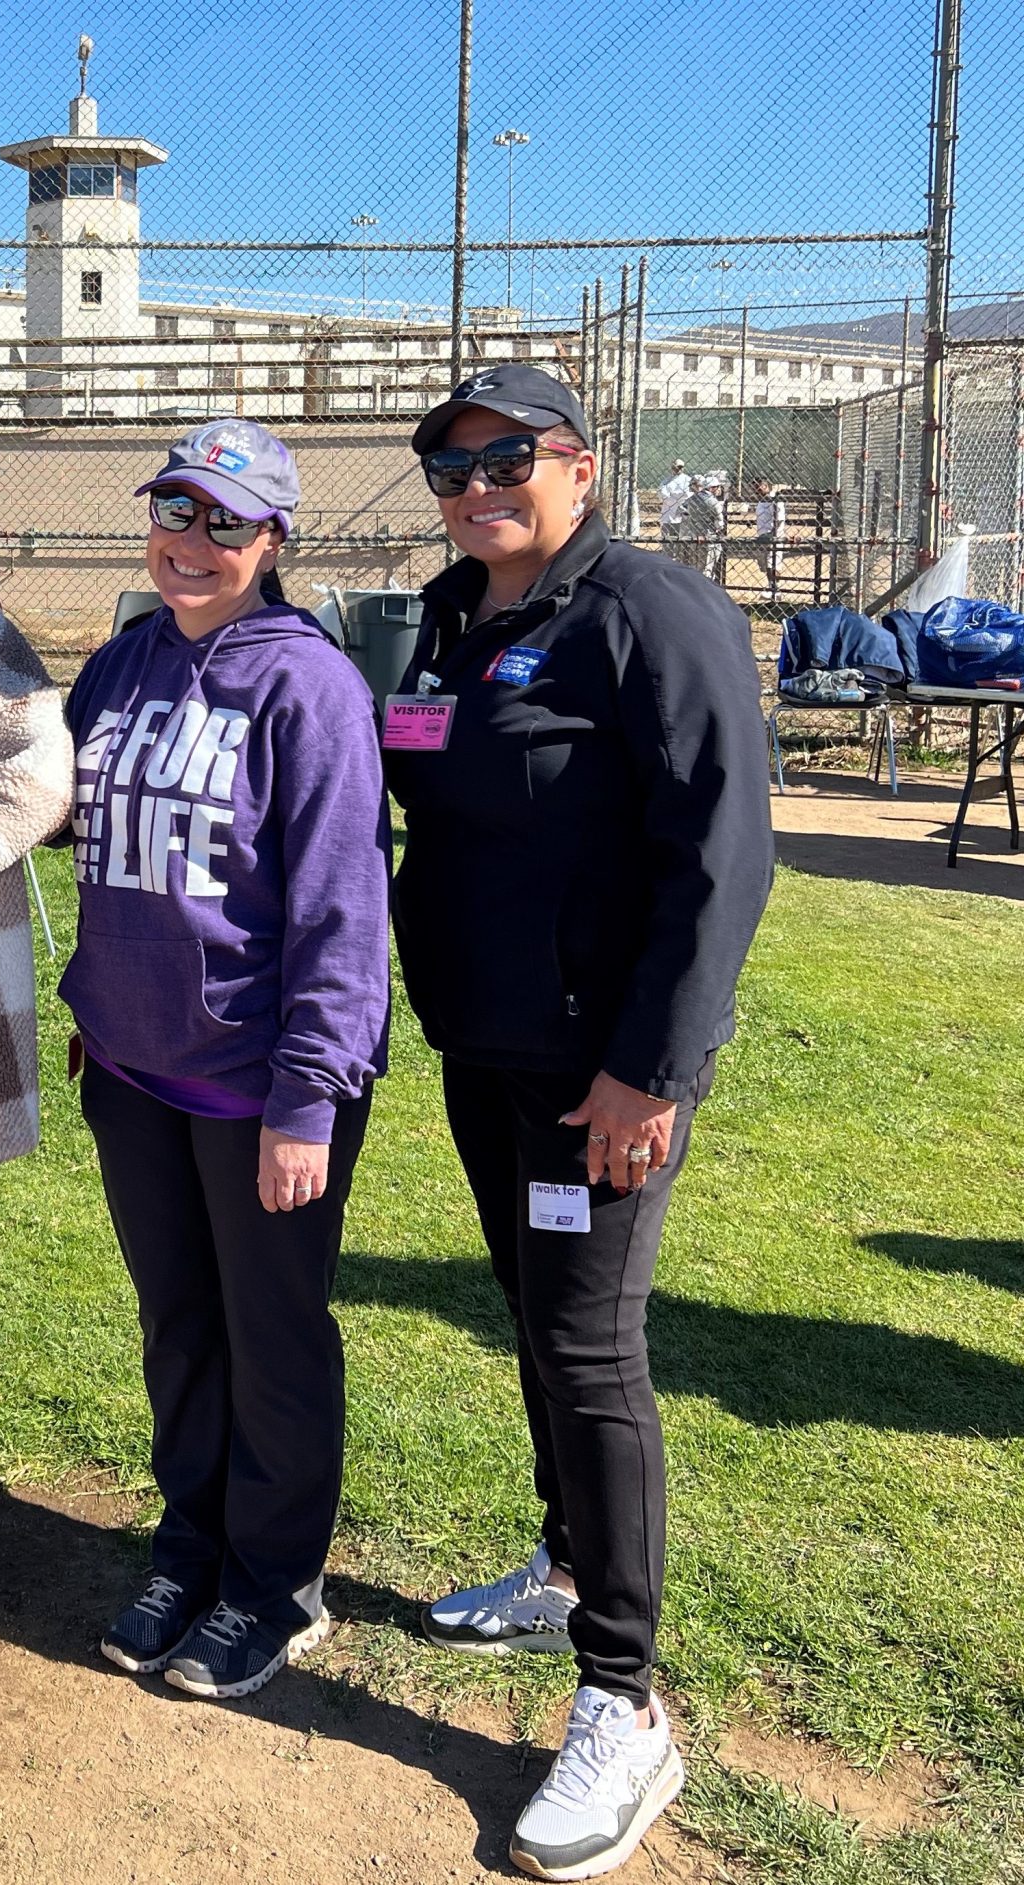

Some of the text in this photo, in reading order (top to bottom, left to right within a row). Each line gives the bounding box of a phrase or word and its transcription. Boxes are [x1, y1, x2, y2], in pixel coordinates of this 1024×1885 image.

[393, 706, 446, 716] VISITOR
[114, 700, 251, 801] FOR
[106, 793, 235, 896] LIFE
[536, 1184, 561, 1195] walk
[563, 1185, 580, 1196] for
